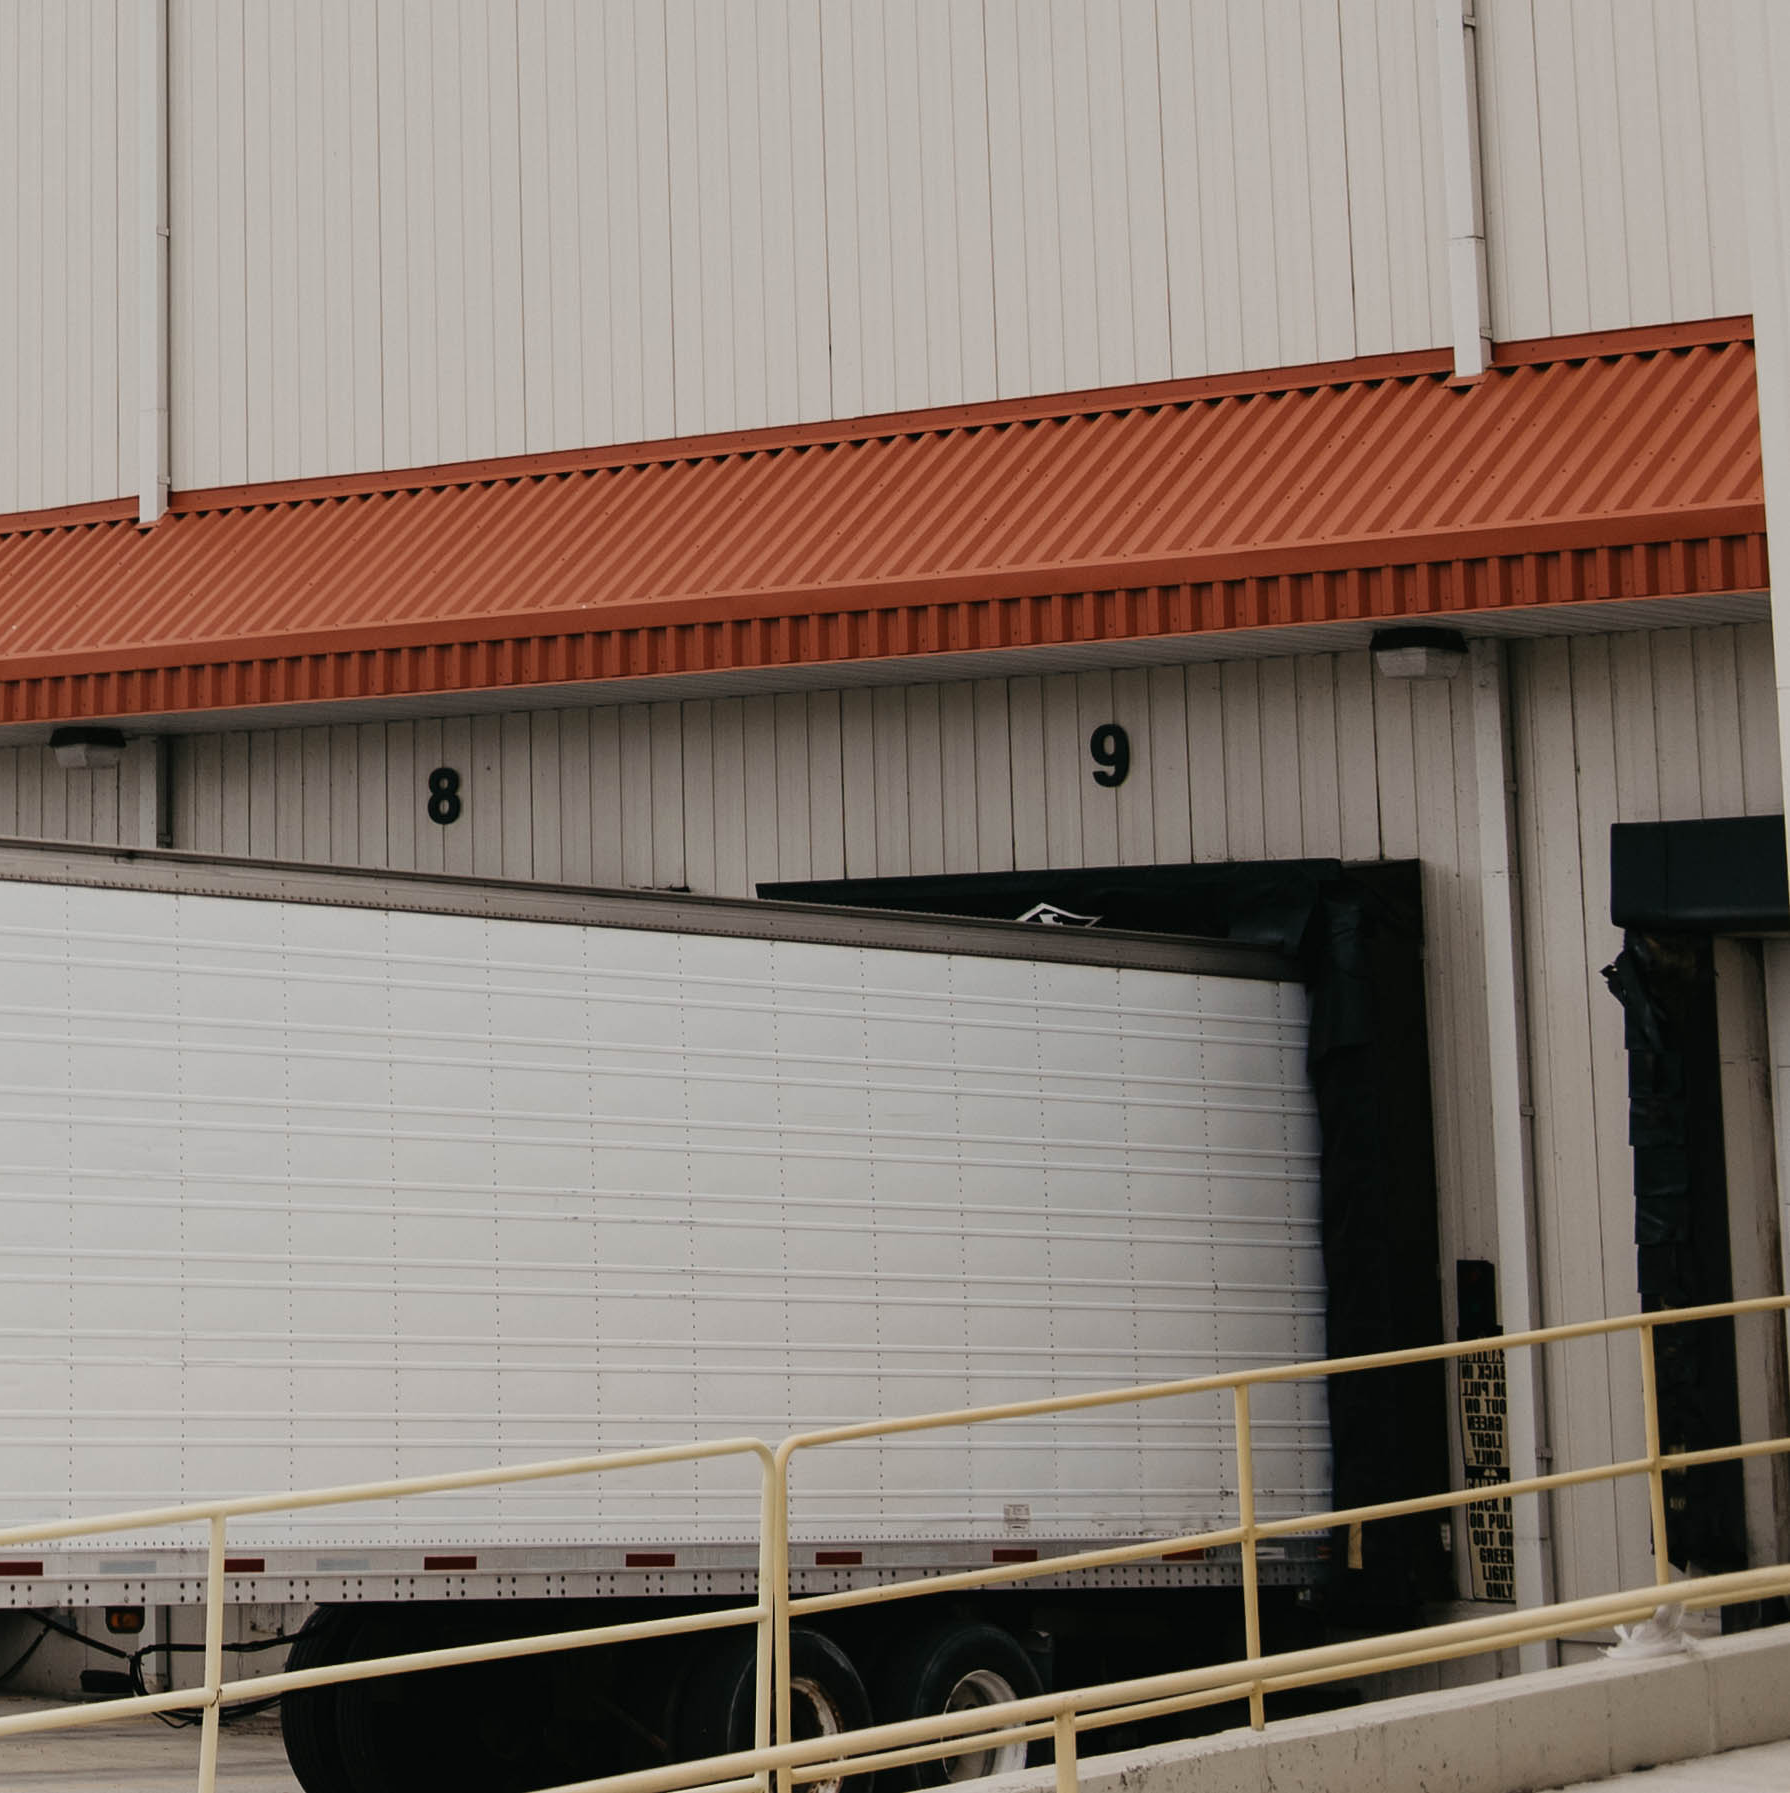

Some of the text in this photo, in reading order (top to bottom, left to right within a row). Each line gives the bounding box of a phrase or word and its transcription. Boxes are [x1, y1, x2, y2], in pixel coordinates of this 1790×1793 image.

[1090, 724, 1130, 787] 9
[428, 767, 462, 825] 8
[1470, 1513, 1485, 1528] OR
[1473, 1530, 1494, 1545] OUT
[1486, 1582, 1513, 1599] ONLY
